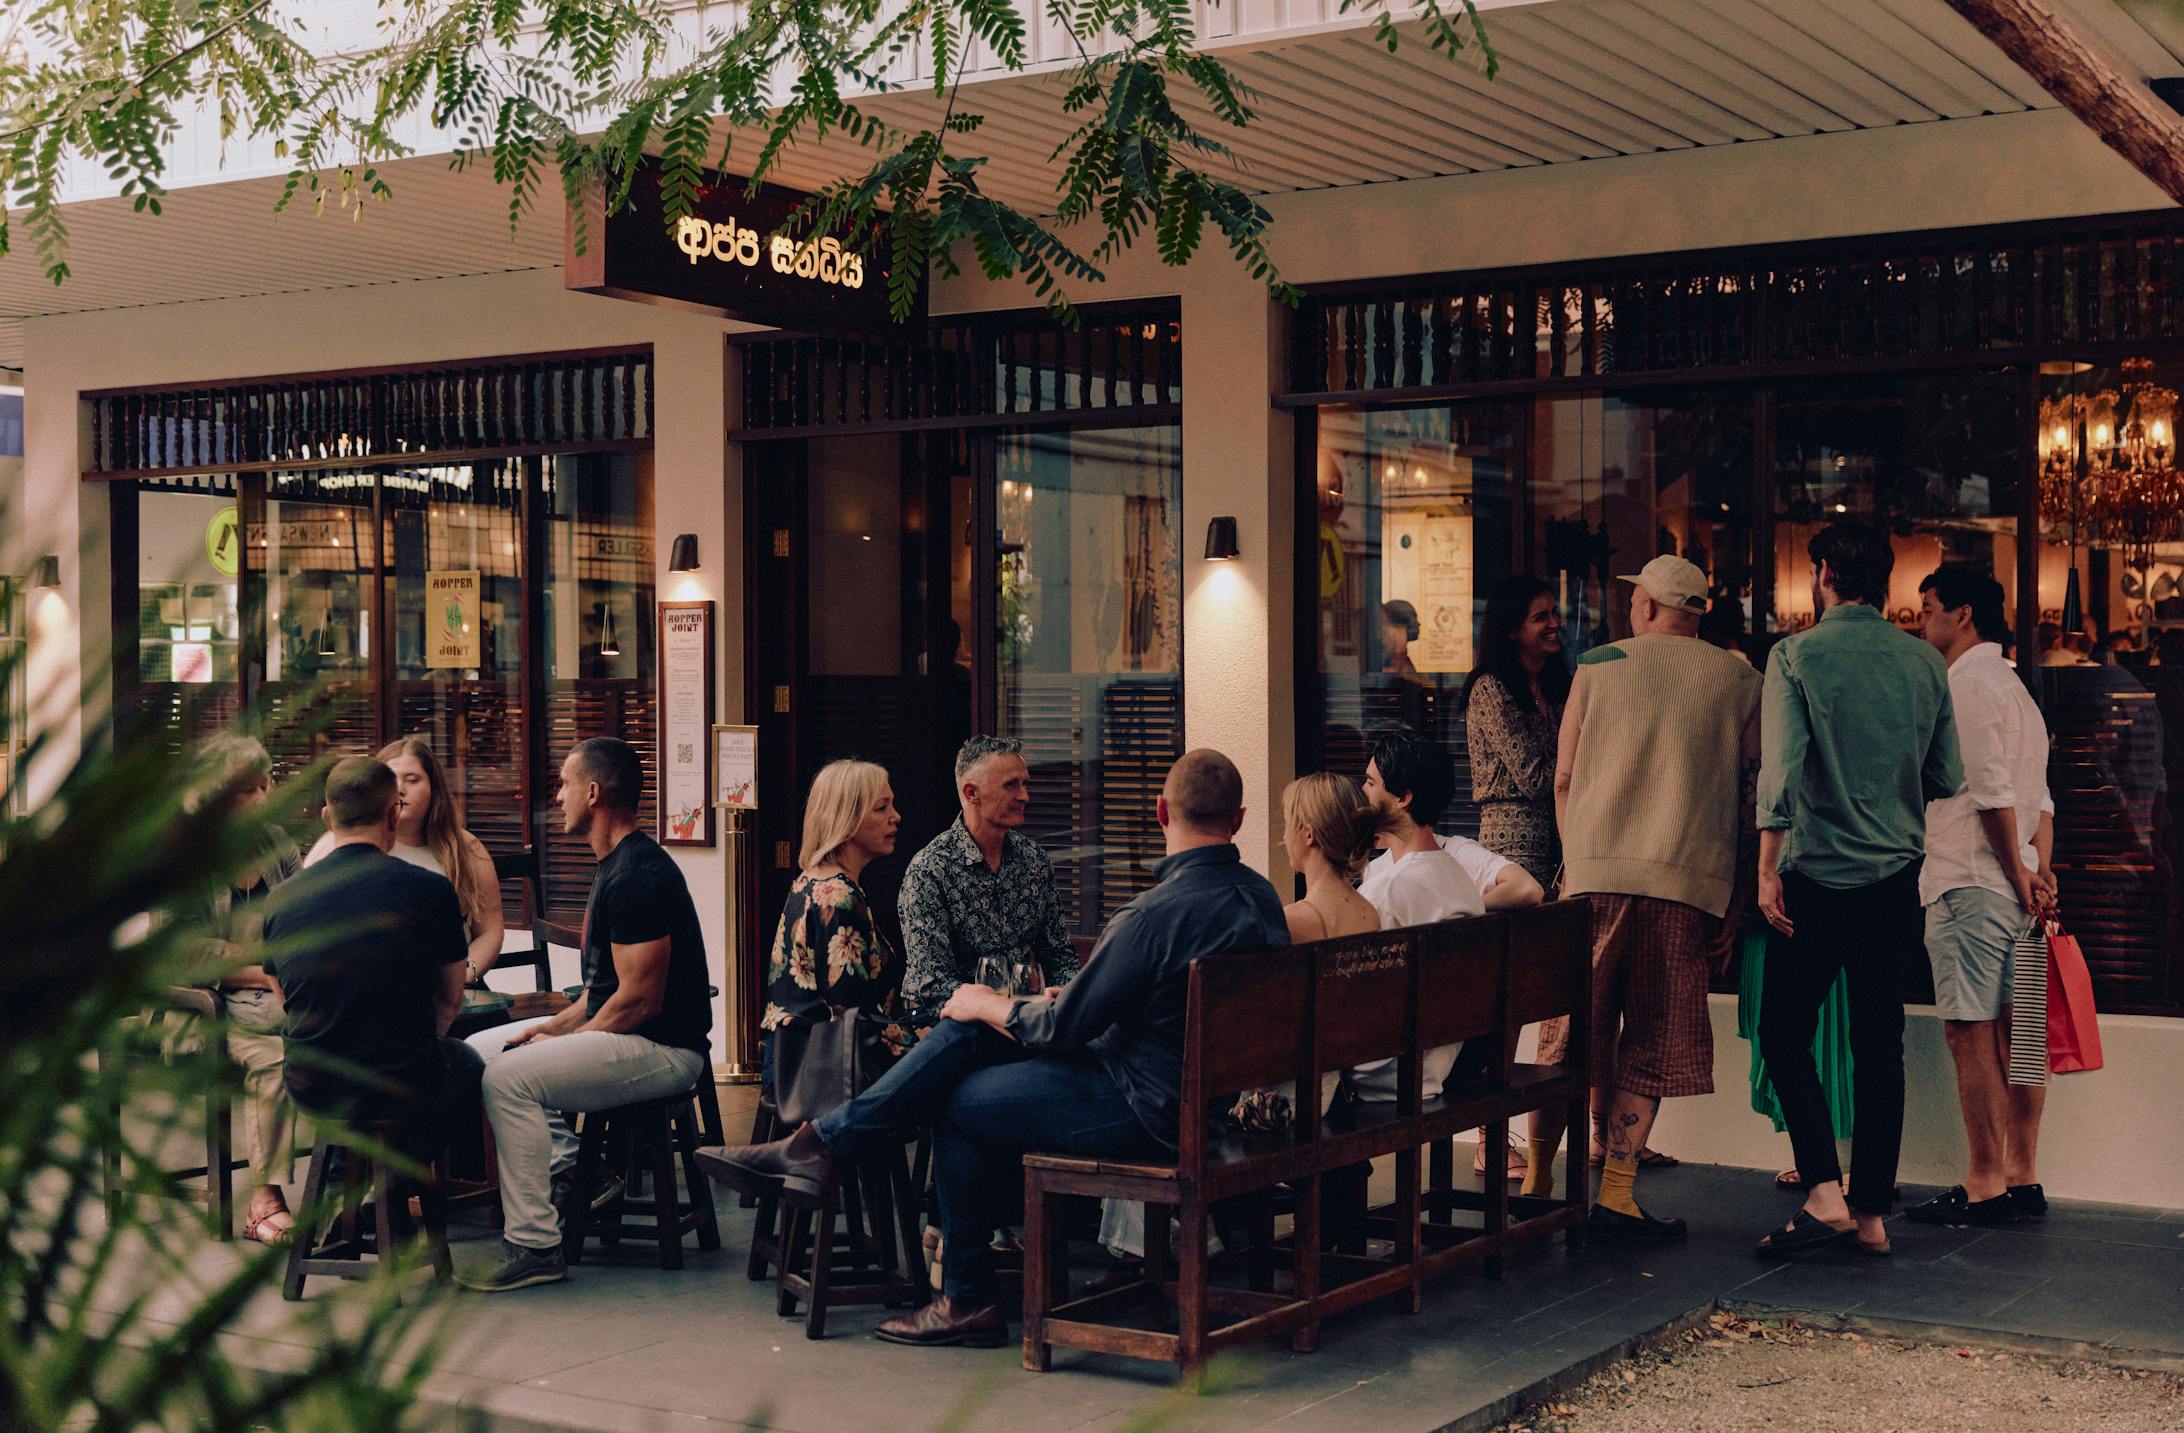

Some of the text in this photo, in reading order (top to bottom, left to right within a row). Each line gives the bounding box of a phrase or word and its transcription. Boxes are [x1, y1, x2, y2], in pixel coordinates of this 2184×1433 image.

[433, 578, 473, 589] HOPPER
[668, 613, 702, 624] HOPPER
[671, 623, 699, 633] JOINT
[439, 645, 470, 656] JOINT
